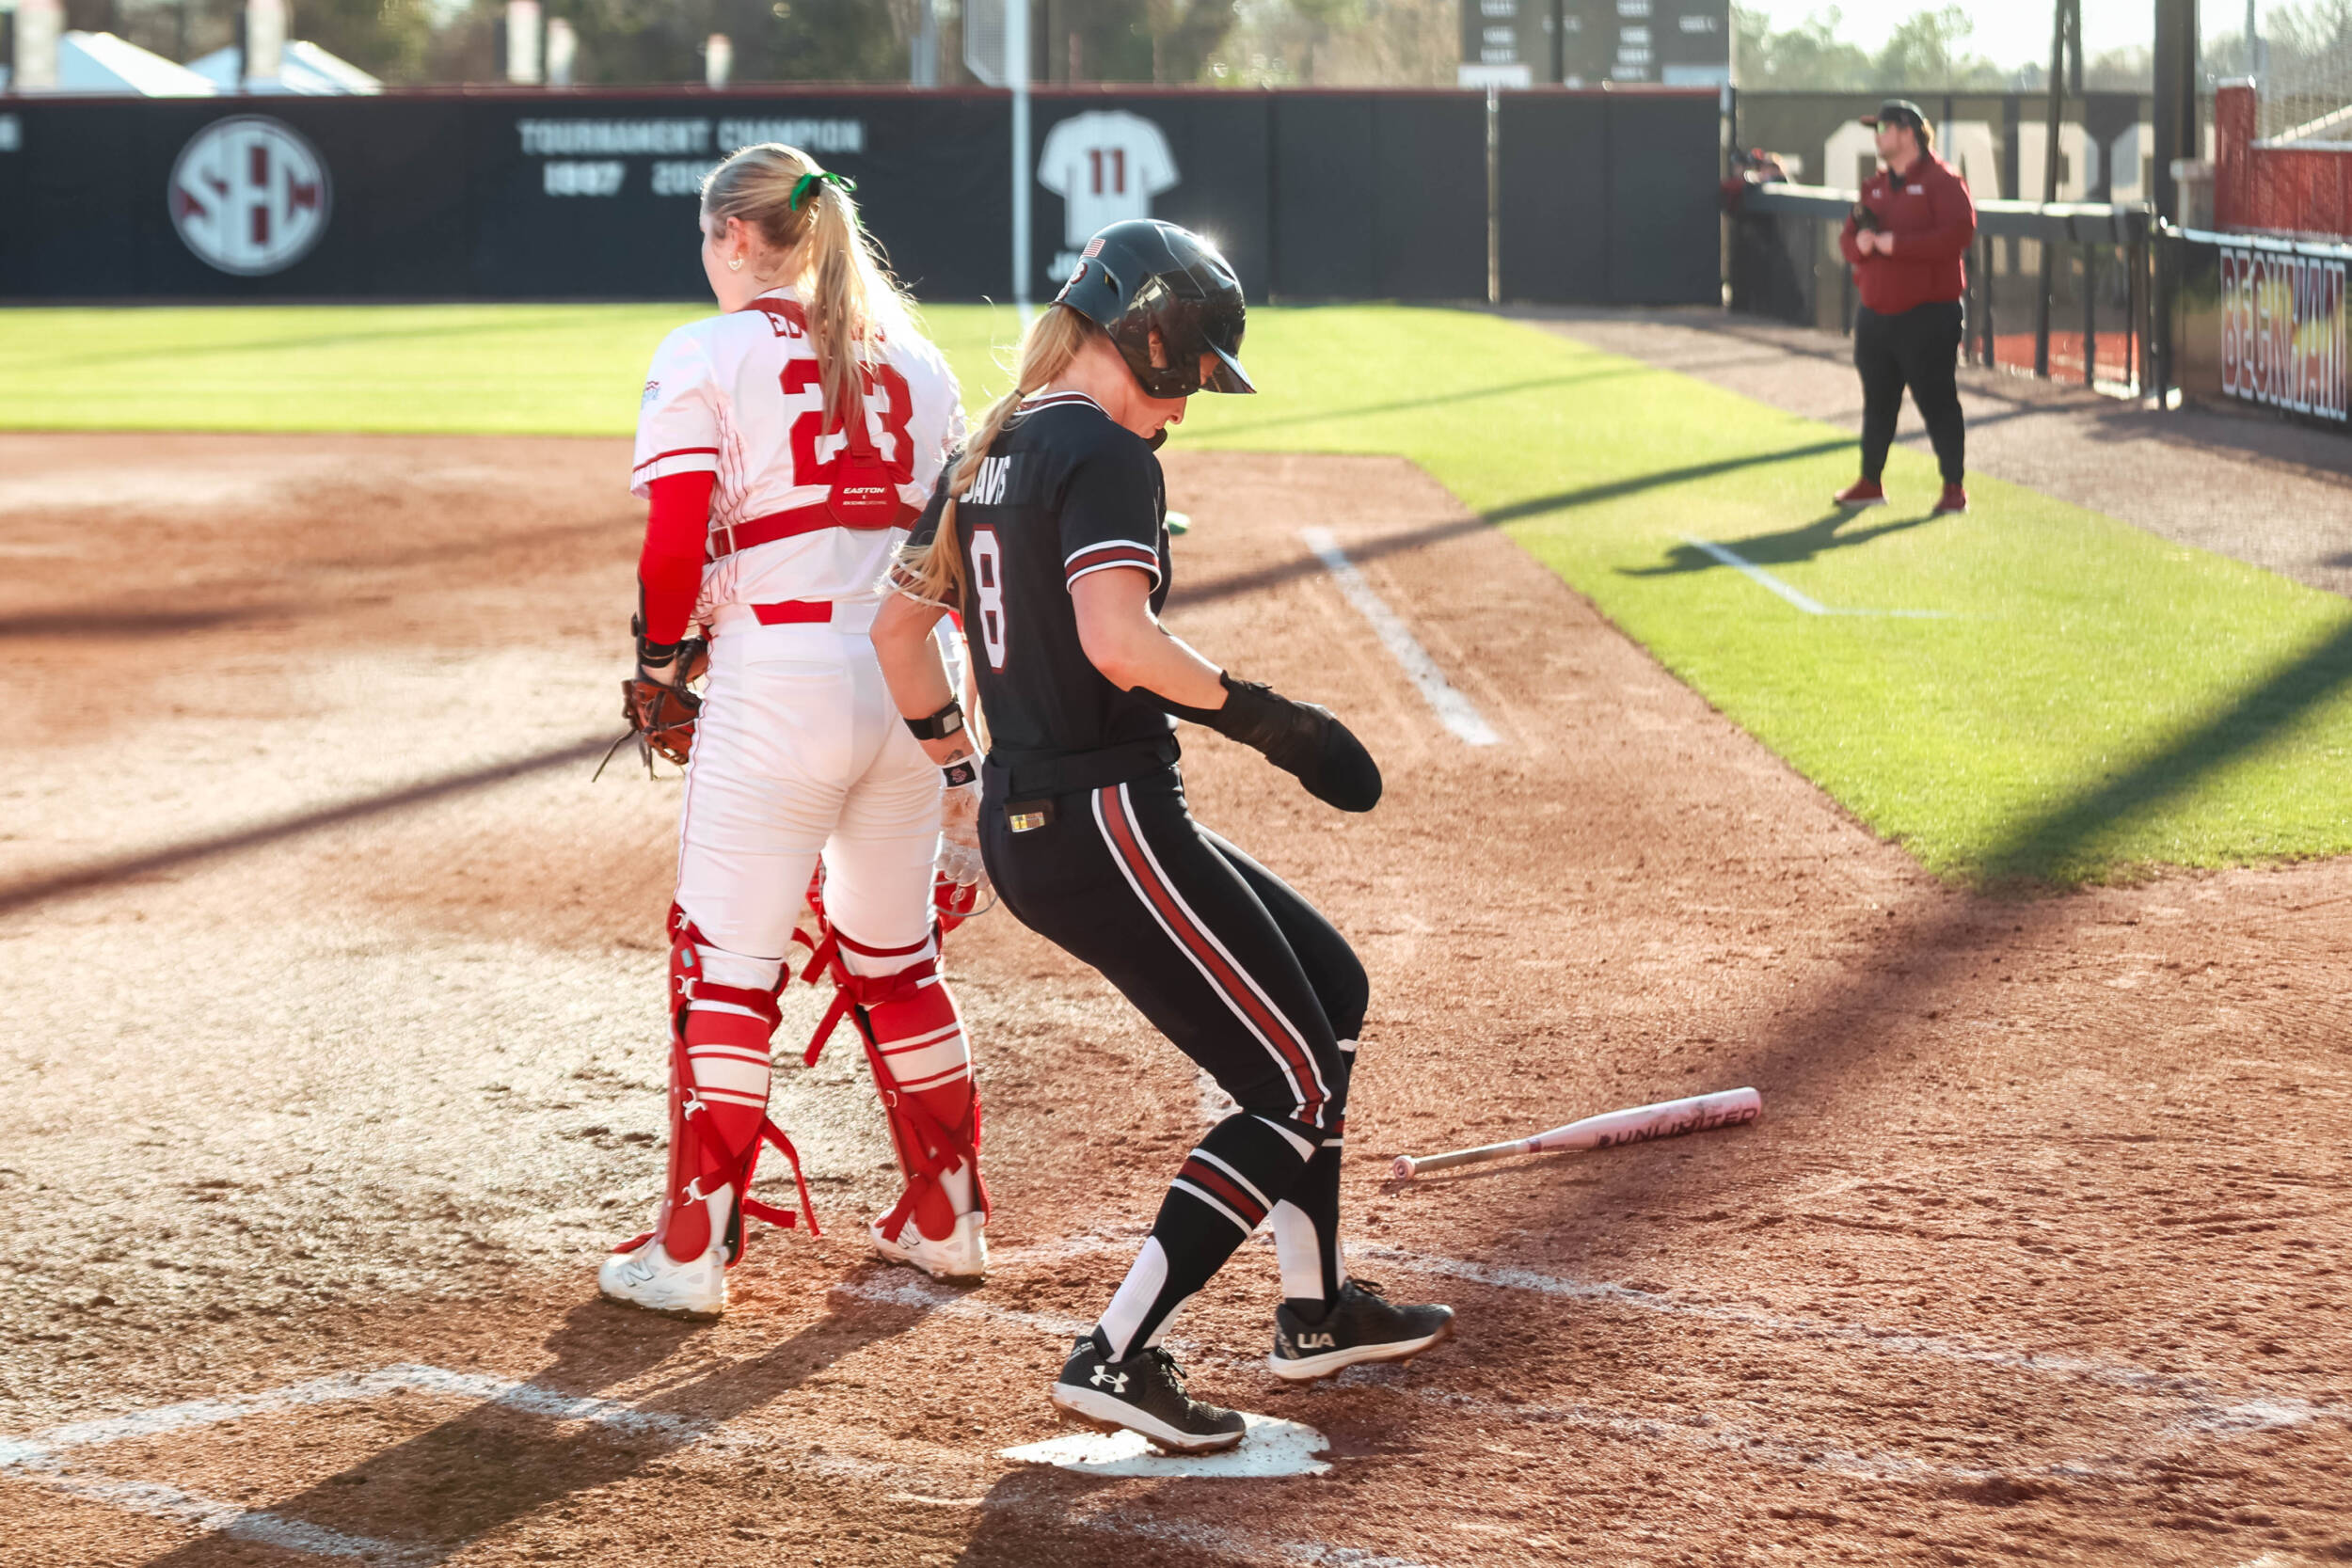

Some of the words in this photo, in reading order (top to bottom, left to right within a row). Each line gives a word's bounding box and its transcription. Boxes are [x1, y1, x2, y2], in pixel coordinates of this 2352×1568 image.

[517, 118, 711, 155] TOURNAMENT
[176, 121, 325, 269] SEC
[1089, 149, 1126, 196] 11
[779, 359, 915, 485] 23
[970, 523, 1009, 674] 8
[1614, 1107, 1758, 1149] UNLIMITED
[1297, 1332, 1336, 1349] UA
